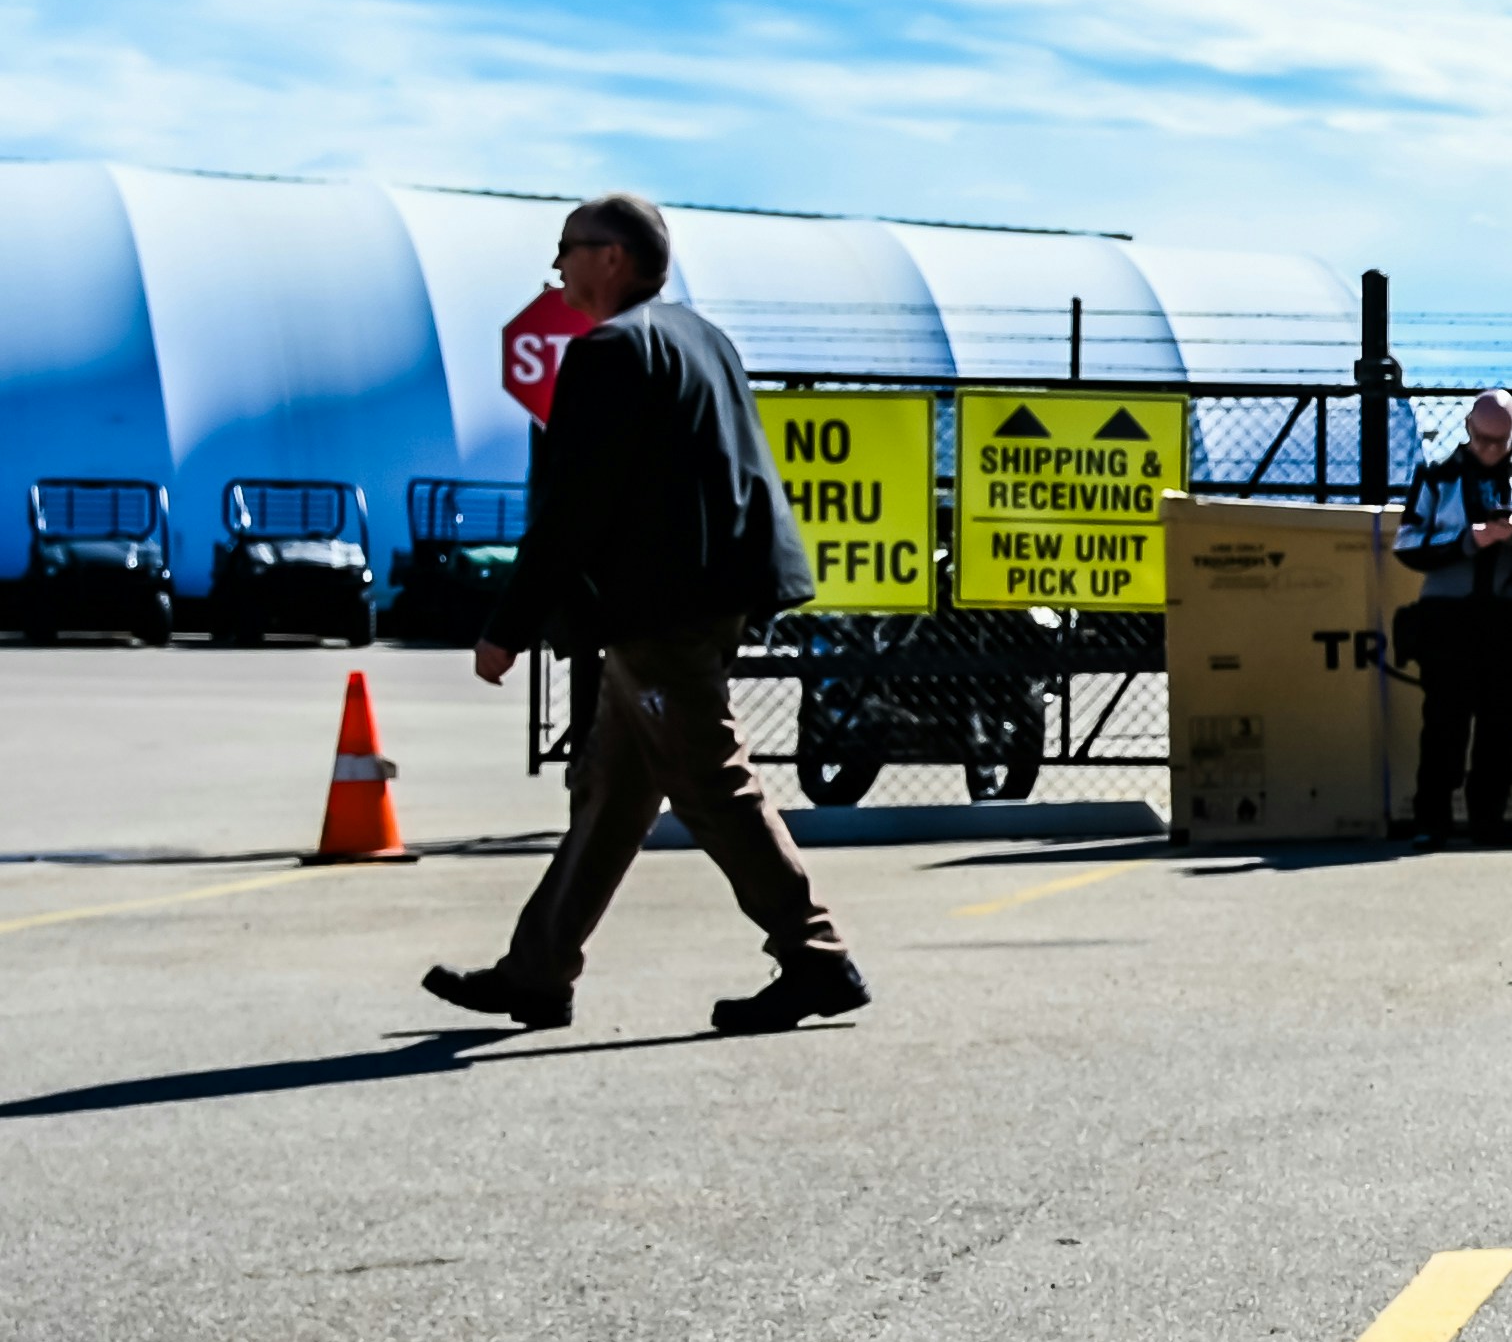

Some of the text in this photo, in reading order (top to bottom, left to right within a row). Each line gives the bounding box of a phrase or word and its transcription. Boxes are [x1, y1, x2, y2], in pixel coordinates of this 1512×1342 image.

[512, 332, 573, 386] ST
[784, 418, 851, 465] NO
[980, 444, 1162, 479] SHIPPING &
[784, 479, 883, 525] HRU
[988, 480, 1154, 514] RECEIVING
[817, 540, 919, 585] FFIC
[991, 532, 1148, 564] NEW UNIT
[1007, 567, 1132, 598] PICK UP
